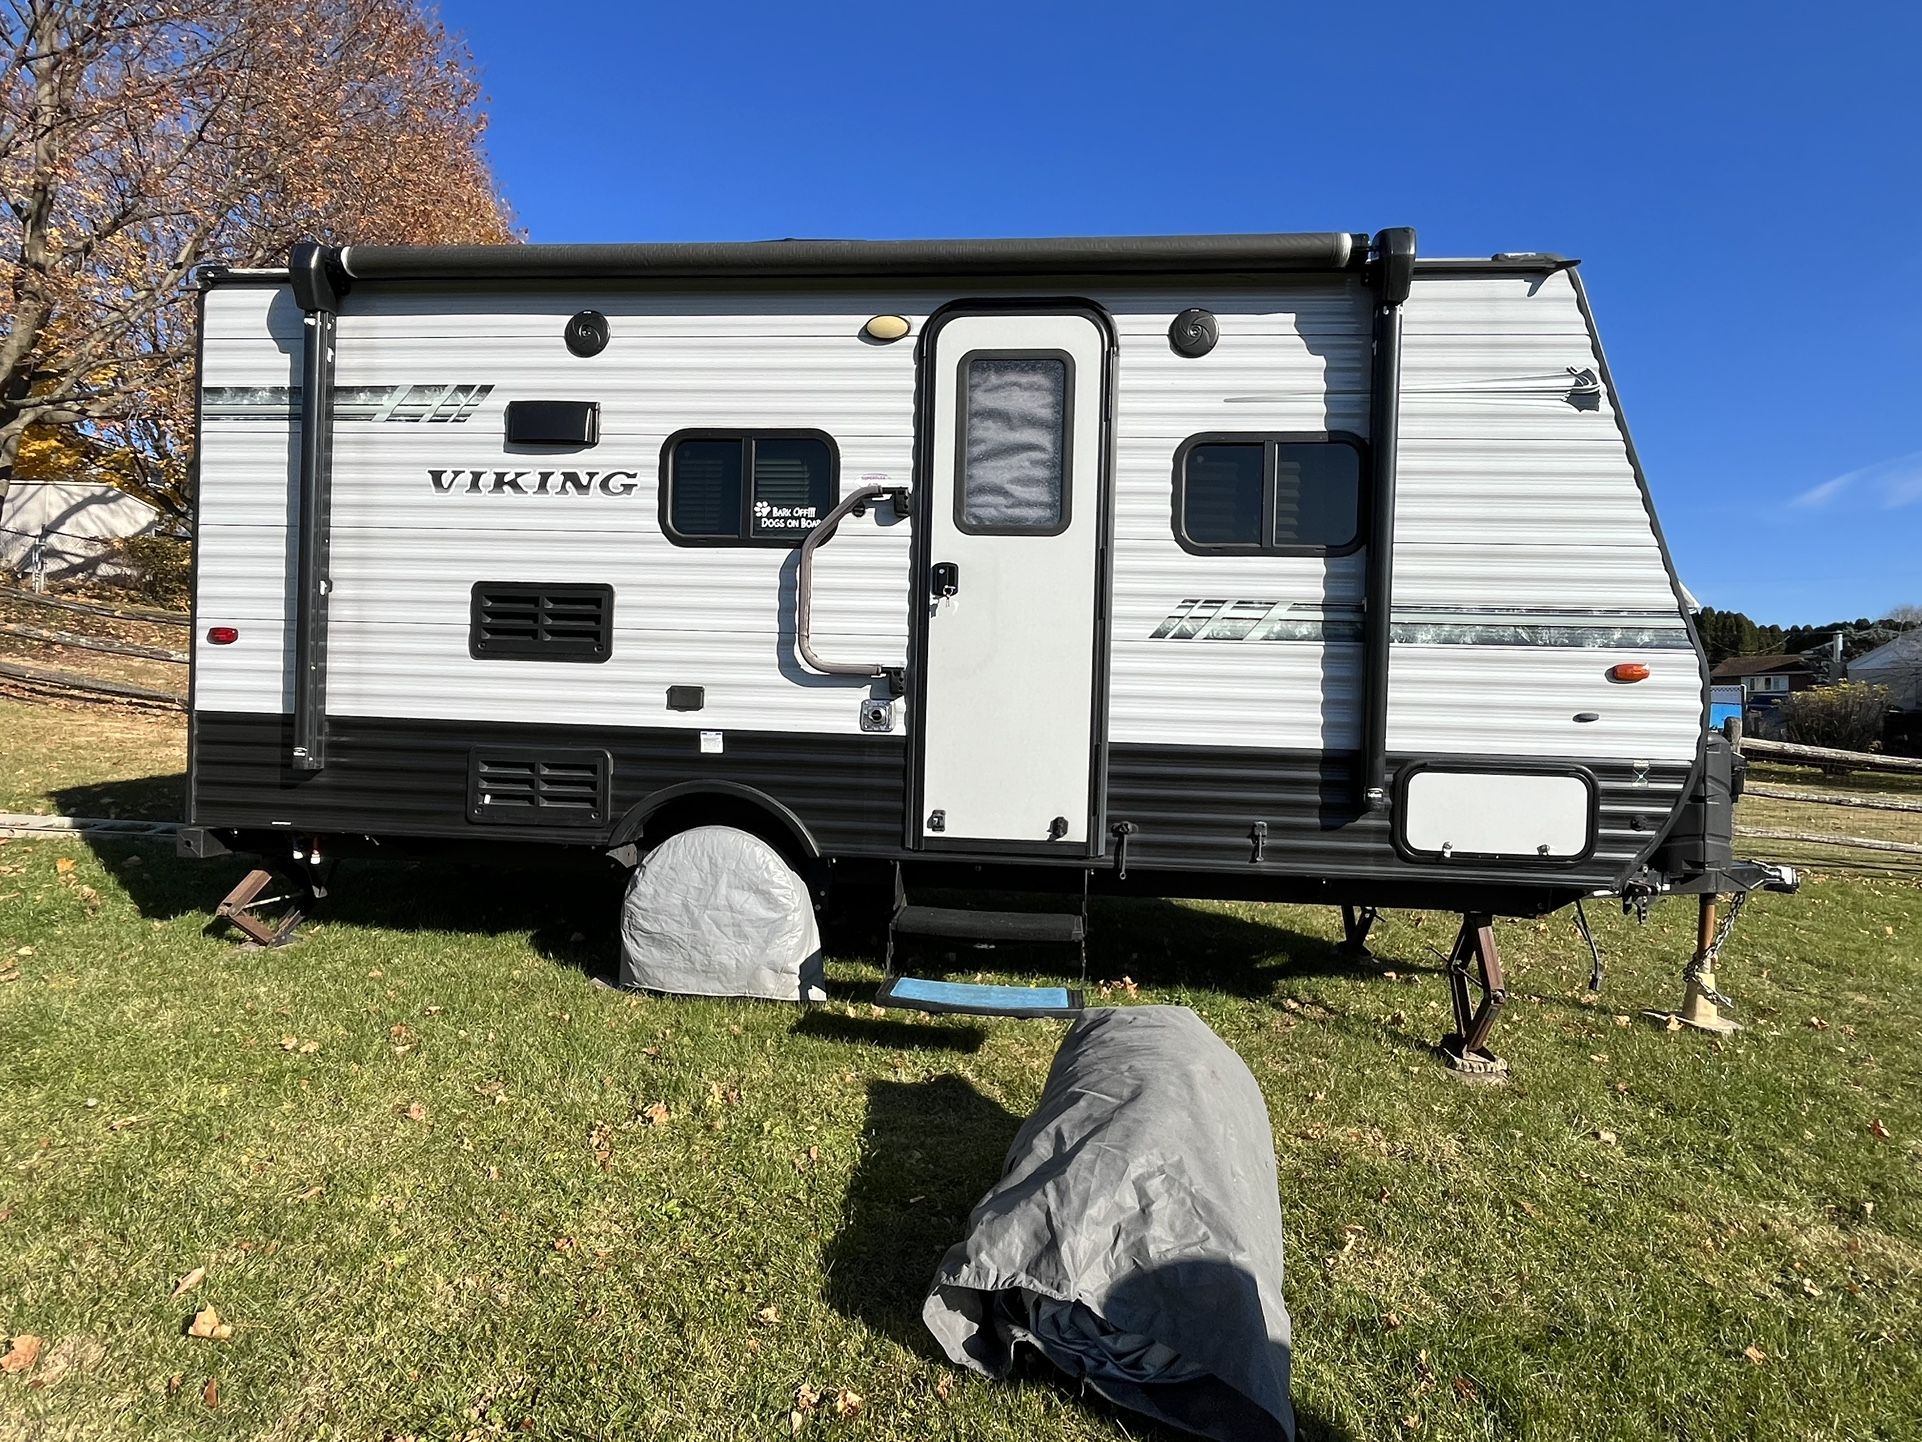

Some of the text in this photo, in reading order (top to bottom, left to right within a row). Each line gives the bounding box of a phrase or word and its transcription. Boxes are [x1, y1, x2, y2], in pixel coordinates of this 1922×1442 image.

[427, 470, 639, 497] VIKING
[772, 506, 791, 517] BARK
[761, 518, 821, 528] DOGS ON BOAR
